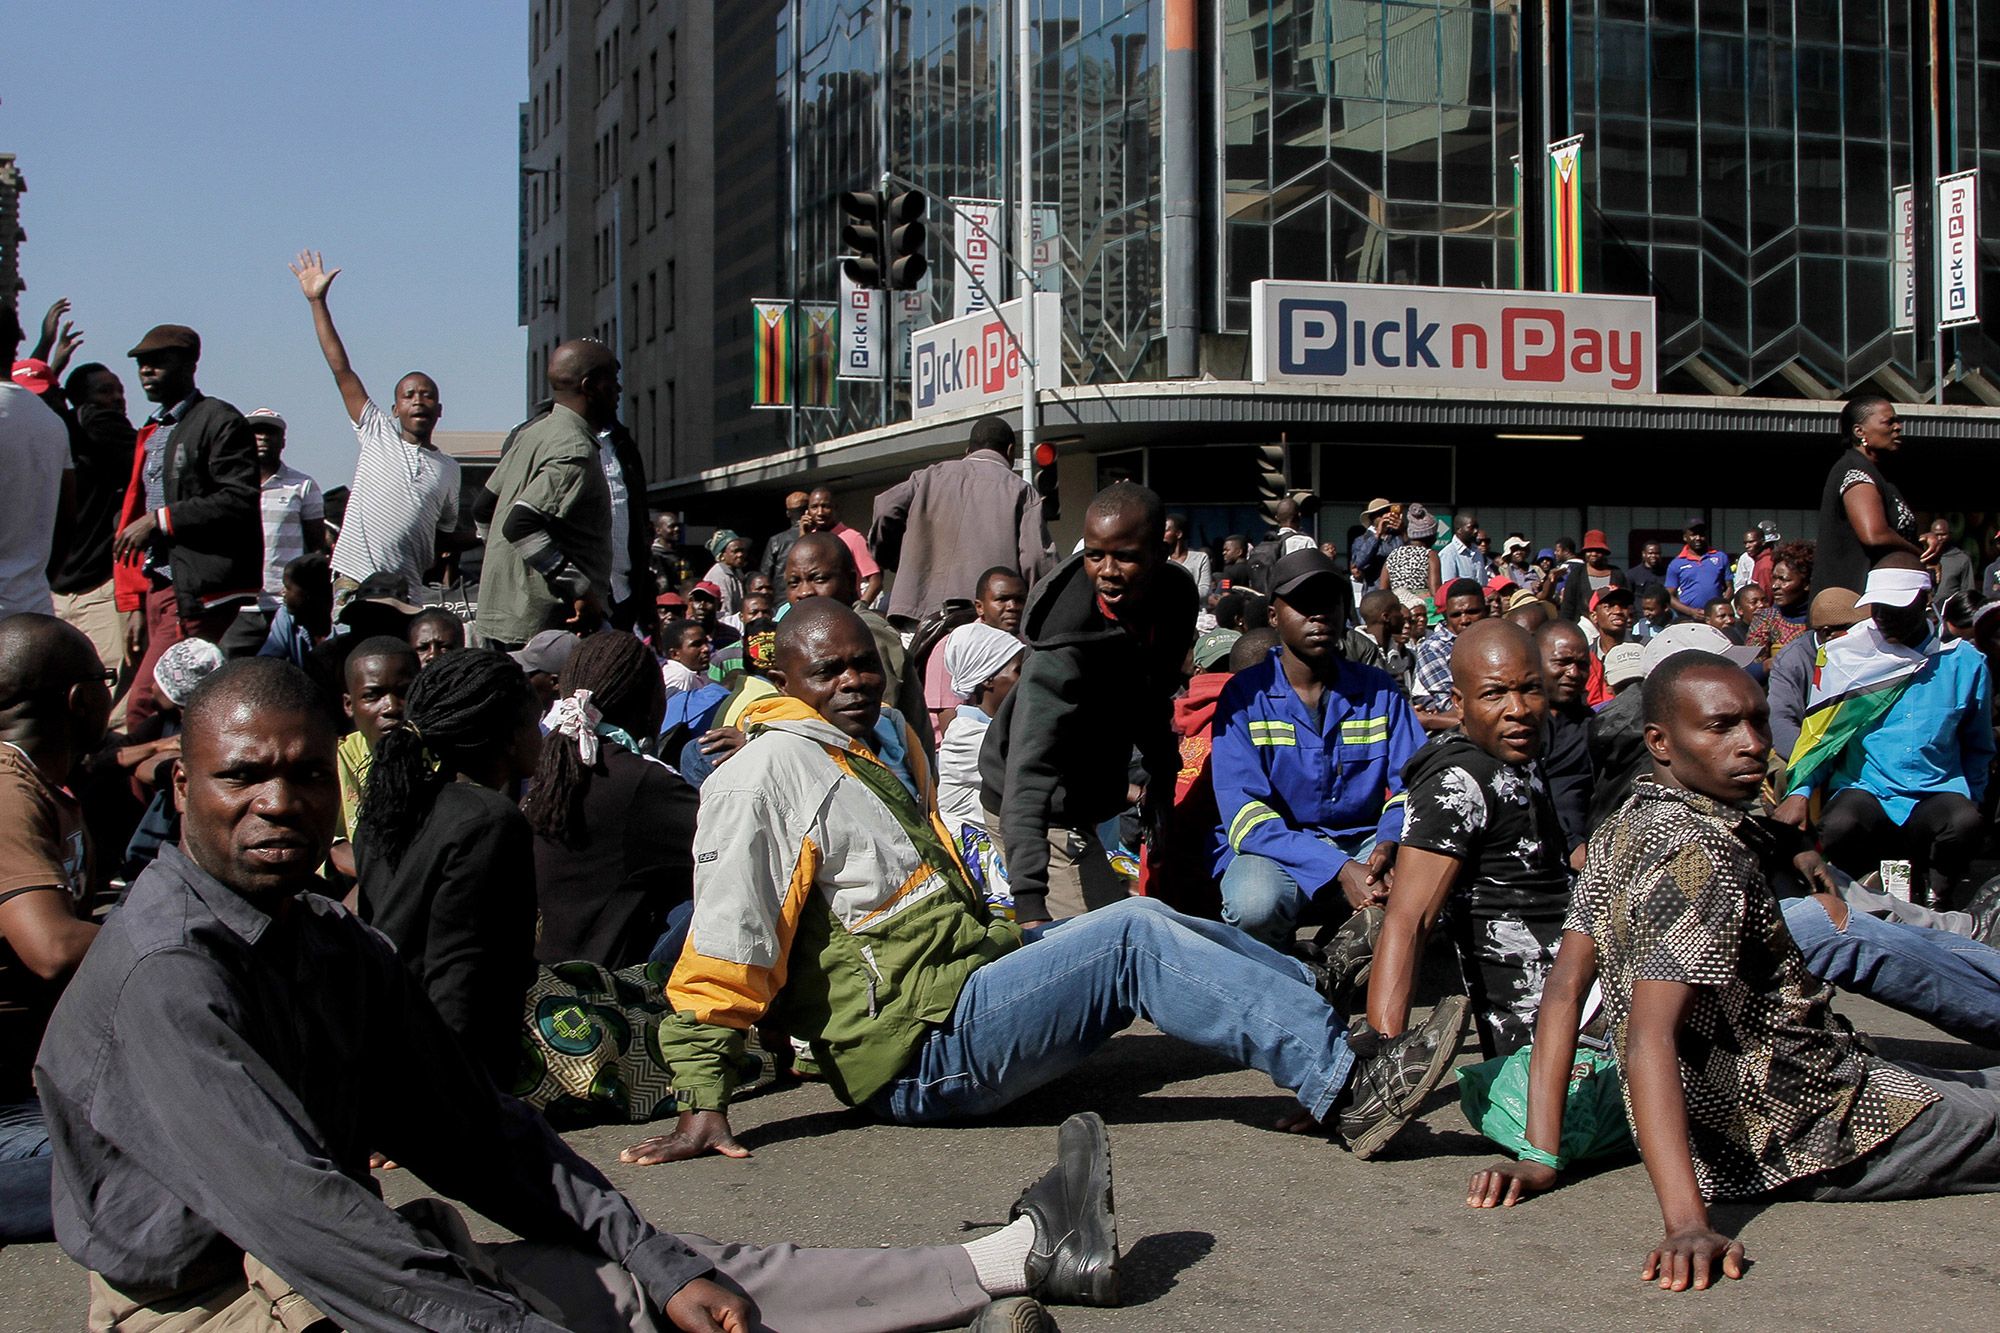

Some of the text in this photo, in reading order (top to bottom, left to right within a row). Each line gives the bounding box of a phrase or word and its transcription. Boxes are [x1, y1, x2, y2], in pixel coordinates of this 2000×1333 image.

[967, 214, 988, 260] Pay
[1949, 188, 1965, 311] Pick n Pay
[851, 326, 869, 368] Pick
[856, 313, 867, 323] n
[1279, 298, 1642, 390] Pick n Pay
[917, 338, 963, 409] Pick
[966, 346, 978, 389] n
[983, 320, 1023, 394] Pa
